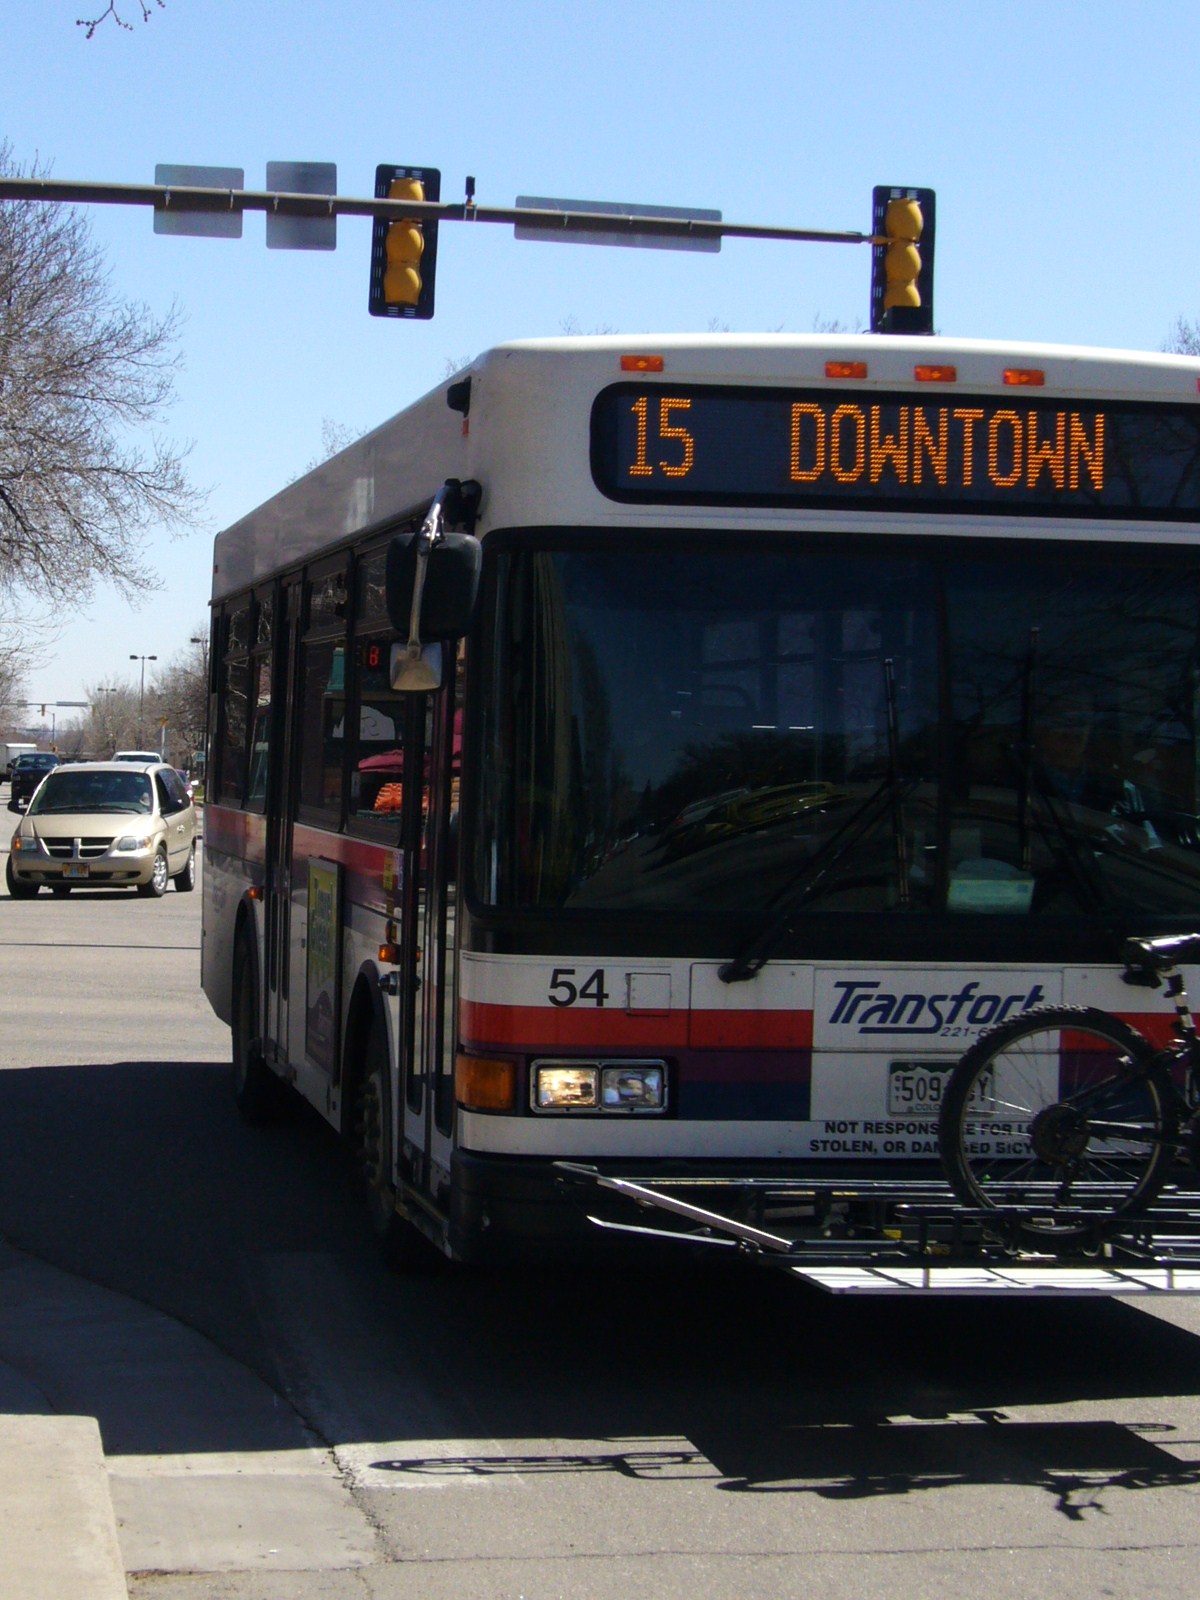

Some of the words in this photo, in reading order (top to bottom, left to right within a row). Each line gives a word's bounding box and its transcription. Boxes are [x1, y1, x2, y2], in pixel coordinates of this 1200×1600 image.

[629, 397, 694, 476] 15
[789, 402, 1105, 489] DOWNTOWN
[548, 968, 609, 1007] 54
[829, 981, 1044, 1034] Transfort
[940, 1026, 988, 1038] 221-6
[825, 1121, 859, 1133] NOT
[863, 1122, 976, 1136] RESPONSE
[980, 1124, 1012, 1135] FOR
[809, 1139, 878, 1154] STOLEN,
[883, 1140, 906, 1152] OR
